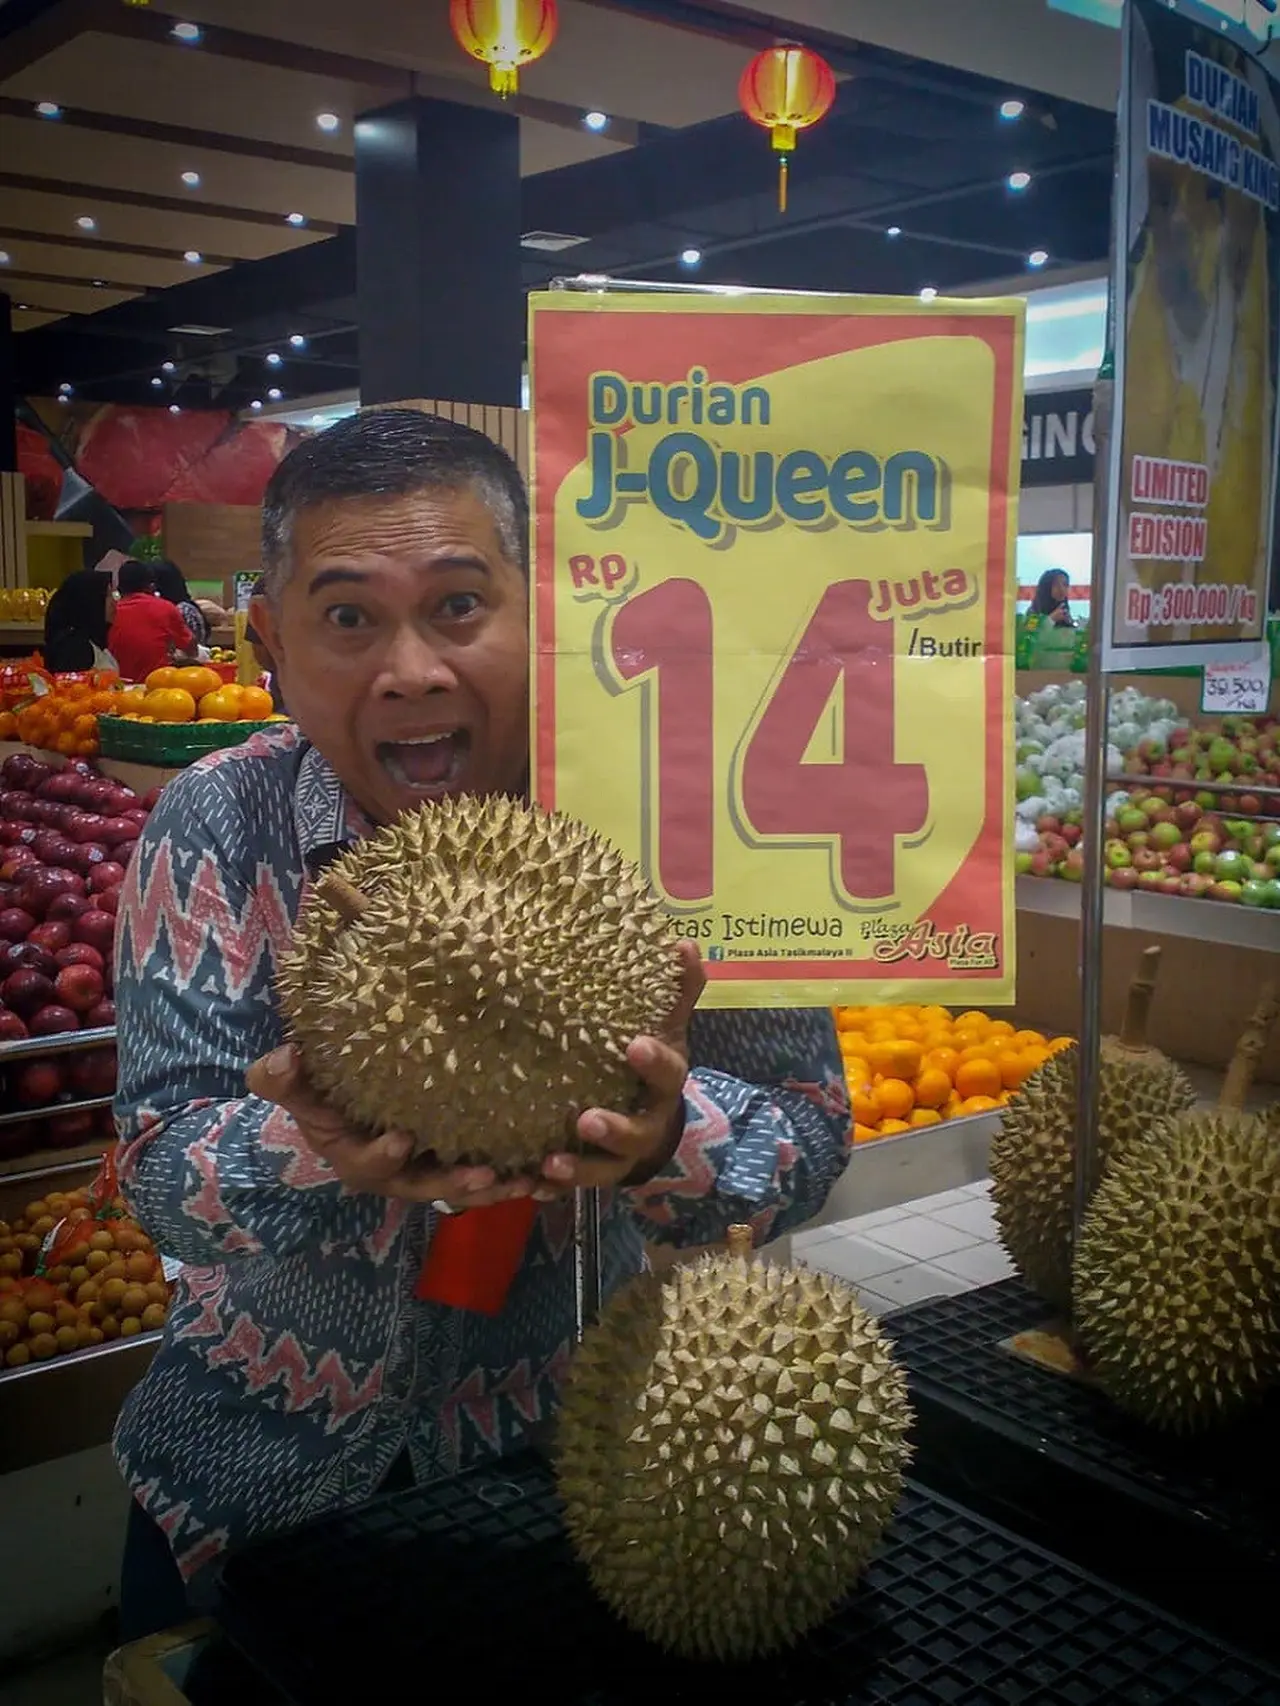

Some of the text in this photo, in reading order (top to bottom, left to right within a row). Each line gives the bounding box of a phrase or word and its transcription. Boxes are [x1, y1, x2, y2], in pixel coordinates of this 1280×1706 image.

[1149, 101, 1280, 207] MUSANG KING
[592, 368, 772, 426] Durian
[575, 431, 938, 540] J-Queen
[1133, 457, 1208, 506] LIMITED
[1130, 514, 1207, 558] EDISION
[568, 553, 628, 591] Rp
[908, 628, 982, 658] /Butir
[610, 577, 930, 901] 14
[721, 913, 844, 941] Istimewa
[859, 918, 913, 940] Plaza
[874, 919, 997, 962] Asia
[728, 948, 754, 957] Plaza
[756, 948, 778, 957] Asia
[781, 948, 843, 958] Tasikmalaya
